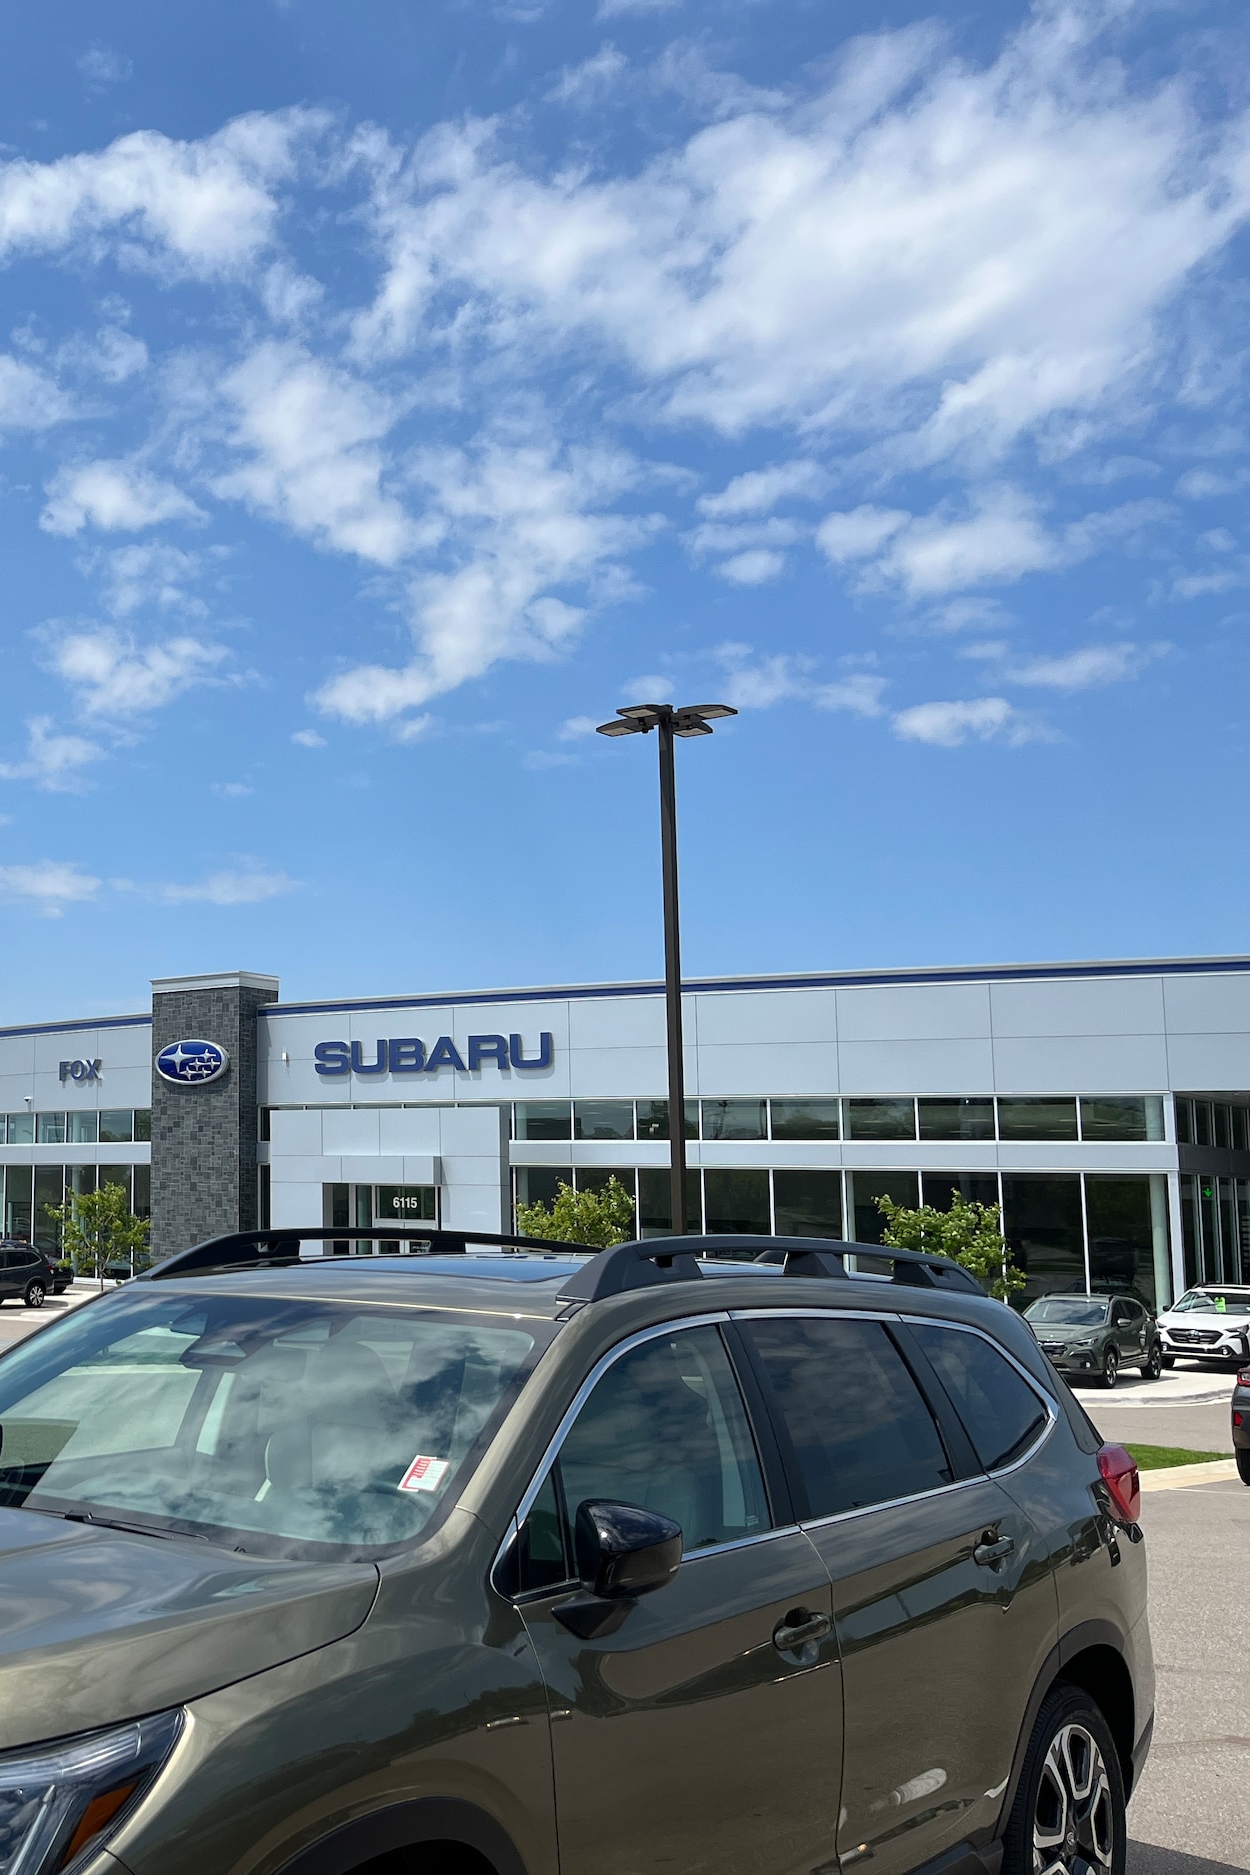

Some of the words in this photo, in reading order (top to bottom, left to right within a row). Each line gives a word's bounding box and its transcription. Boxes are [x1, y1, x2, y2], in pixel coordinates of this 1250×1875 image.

[314, 1032, 552, 1075] SUBARU
[59, 1058, 102, 1081] FOX
[392, 1196, 418, 1209] 6115
